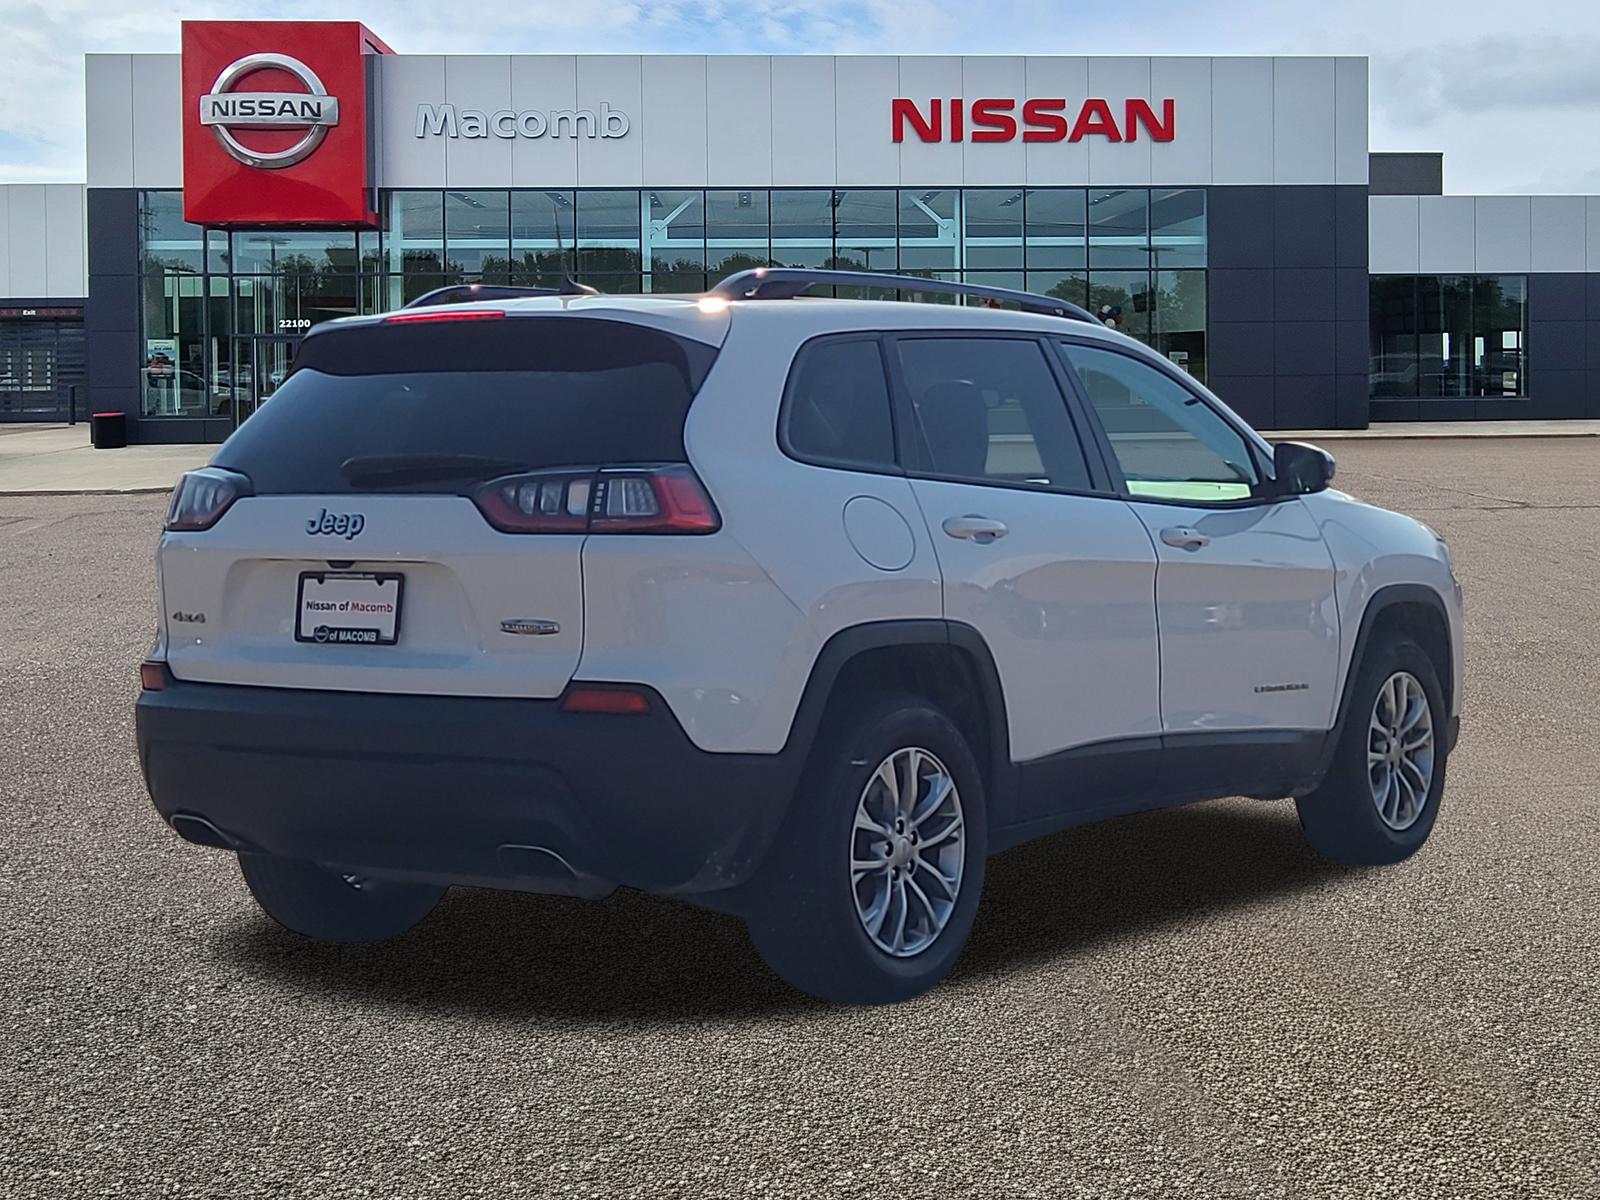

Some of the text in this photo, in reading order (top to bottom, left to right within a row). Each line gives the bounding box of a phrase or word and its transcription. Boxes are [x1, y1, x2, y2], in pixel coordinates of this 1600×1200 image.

[212, 100, 322, 118] NISSAN
[415, 102, 630, 138] Macomb
[892, 98, 1175, 143] NISSAN
[279, 319, 311, 328] 22100
[305, 508, 365, 541] Jeep
[306, 601, 394, 613] Nissan of Macomb
[329, 631, 377, 642] of MACOMB
